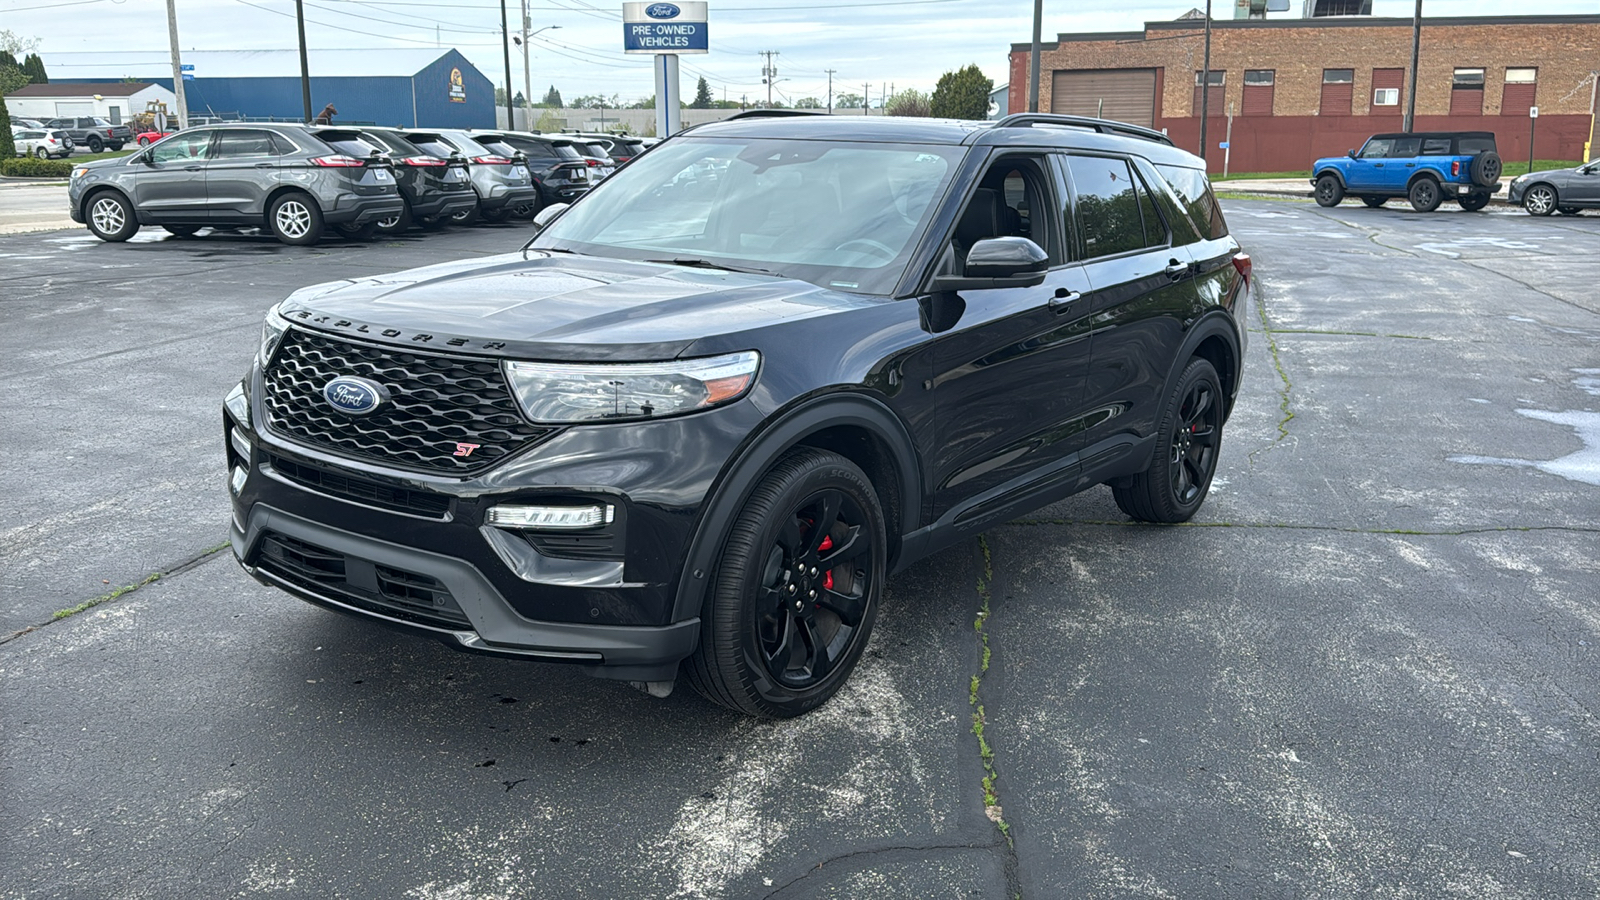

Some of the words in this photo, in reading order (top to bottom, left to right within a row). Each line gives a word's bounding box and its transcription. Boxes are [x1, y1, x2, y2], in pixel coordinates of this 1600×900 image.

[652, 6, 673, 16] Ford
[632, 25, 696, 35] PRE-OWNED
[639, 36, 689, 46] VEHICLES
[297, 311, 506, 350] EXPLORER
[333, 384, 364, 407] Ford
[453, 442, 481, 457] ST
